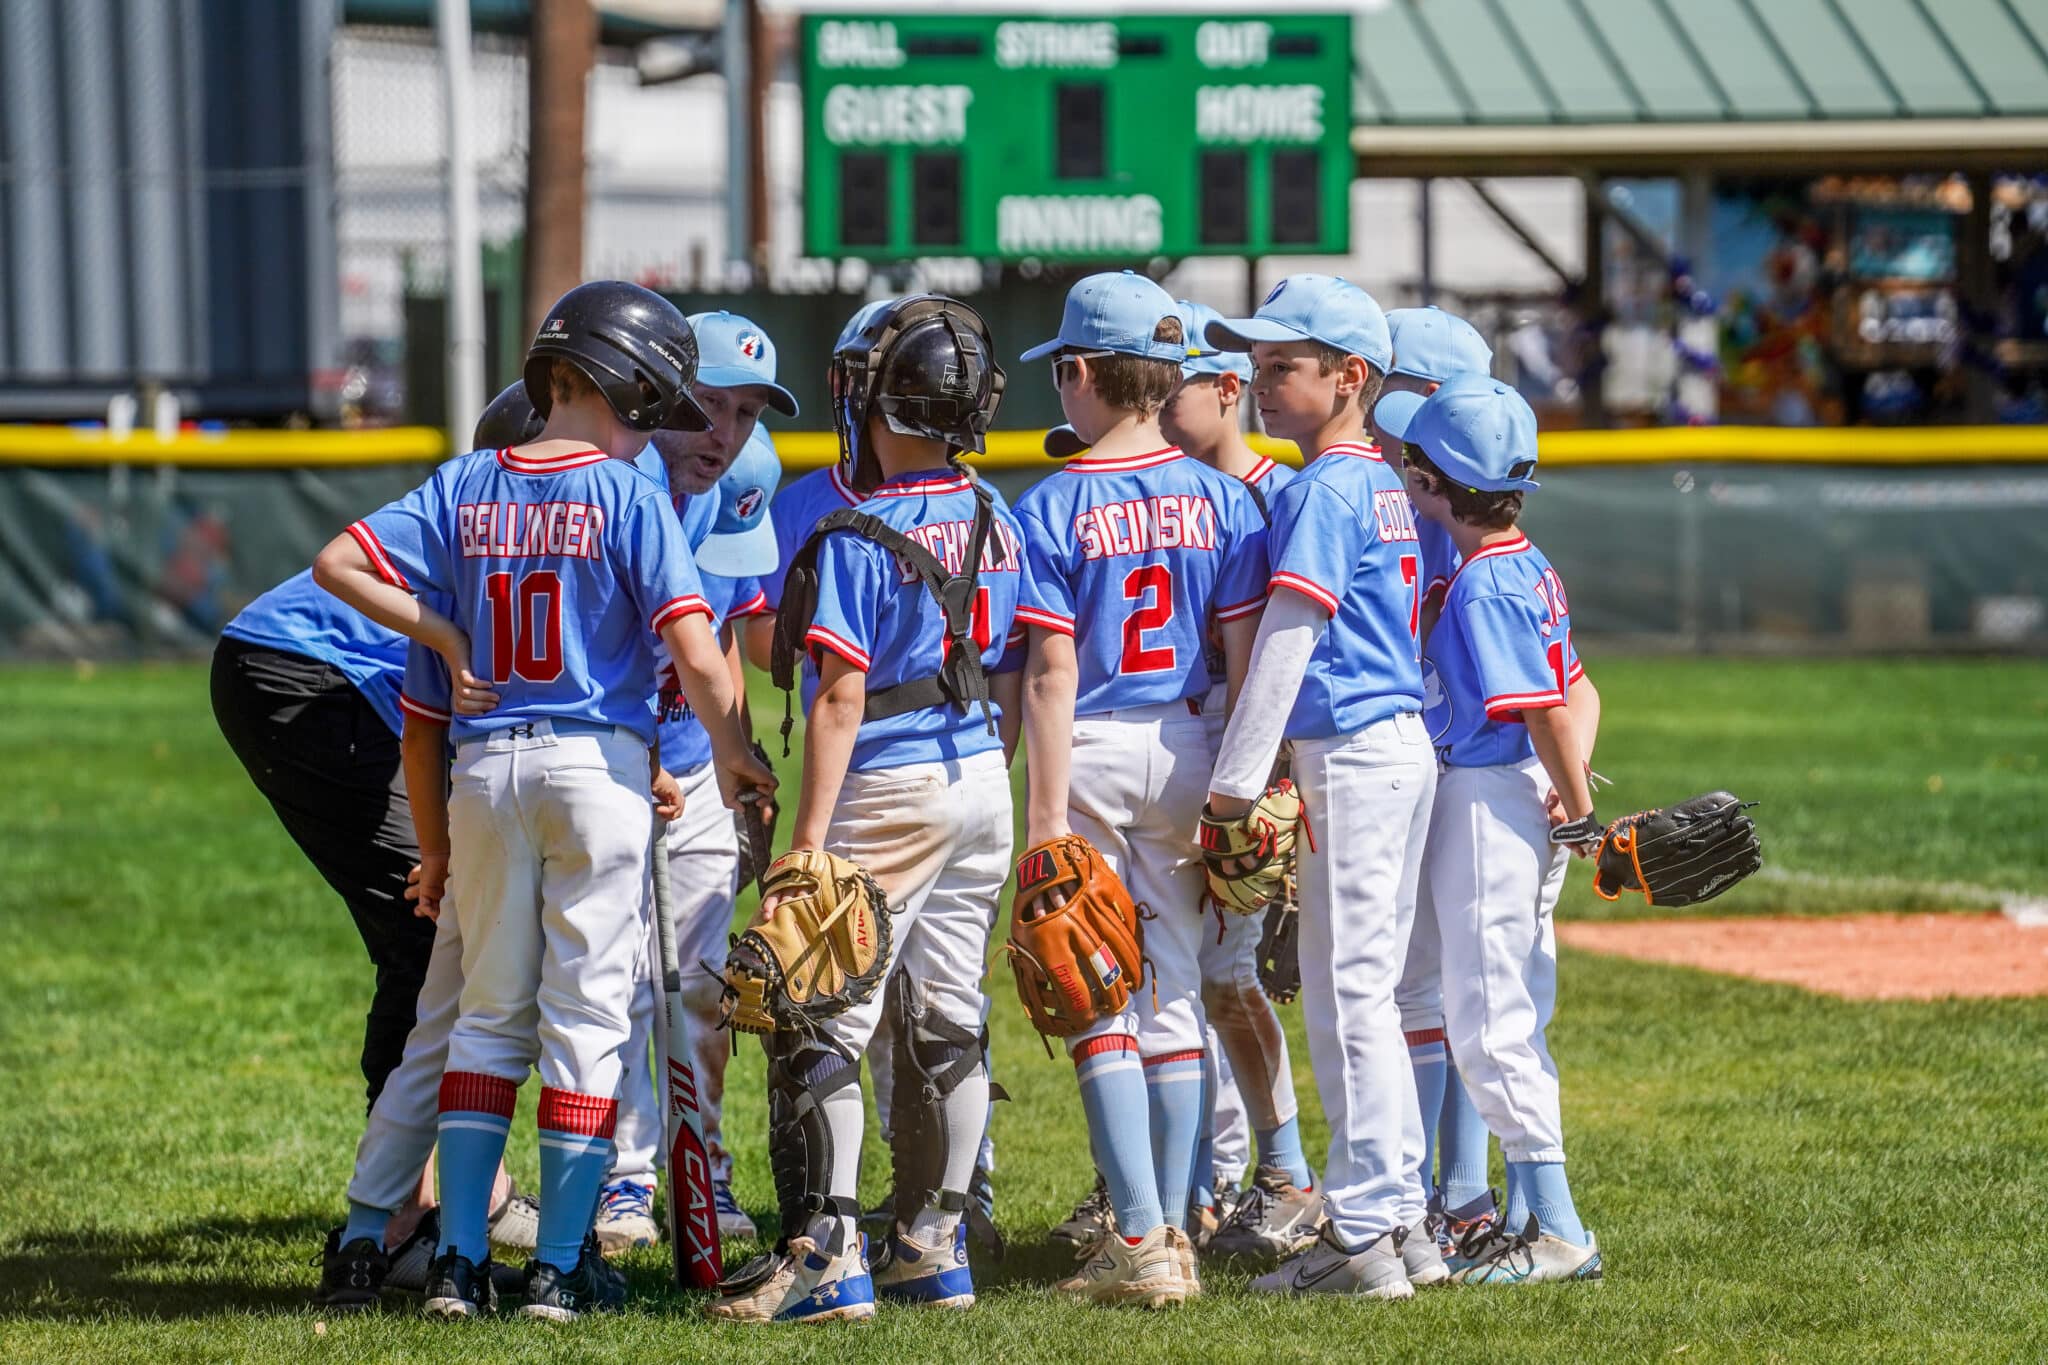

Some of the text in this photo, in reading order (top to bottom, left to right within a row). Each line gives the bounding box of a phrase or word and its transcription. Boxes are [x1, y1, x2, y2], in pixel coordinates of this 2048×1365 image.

[818, 21, 906, 68] BALL
[995, 21, 1119, 68] STRIKE
[1196, 21, 1272, 68] OUT
[824, 84, 973, 145] GUEST
[1196, 84, 1324, 142] HOME
[997, 195, 1163, 253] INNING
[458, 502, 604, 560] BELLINGER
[1074, 495, 1216, 560] SICINSKI
[486, 570, 564, 684] 10
[1118, 562, 1176, 676] 2
[684, 1148, 719, 1279] CATX
